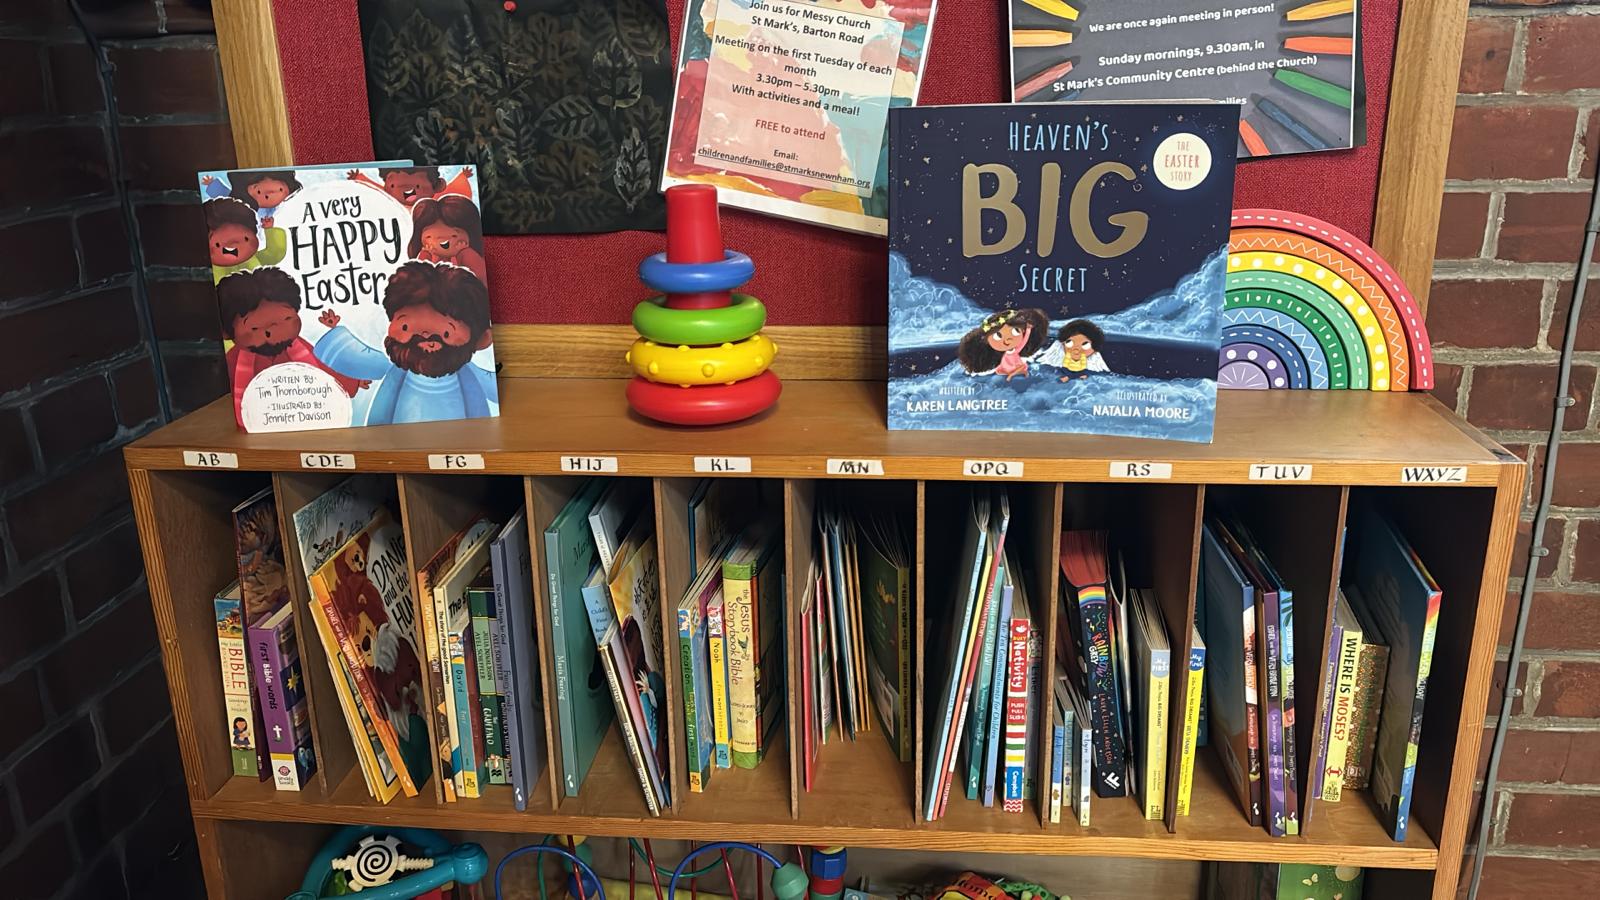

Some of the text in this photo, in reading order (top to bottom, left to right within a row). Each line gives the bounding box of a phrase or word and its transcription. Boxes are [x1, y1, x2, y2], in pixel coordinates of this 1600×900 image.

[749, 0, 871, 29] Join us for Messy Church
[1089, 3, 1274, 32] We are once again meeting in person!
[751, 15, 864, 44] St Mark's, Barton Road
[714, 35, 892, 75] Meeting on the first Tuesday of each
[1098, 40, 1264, 66] Sunday mornings, 9.30am, in
[784, 64, 816, 77] month
[1053, 55, 1317, 92] St Mark's Community Centre (behind the Church)
[756, 73, 792, 87] 3.30pm
[802, 82, 840, 97] 5.30pm
[732, 84, 755, 96] With
[757, 89, 800, 105] activities
[802, 97, 821, 108] and
[831, 104, 860, 116] meal!
[755, 119, 826, 140] FREE to attend
[1008, 121, 1109, 151] HEAVEN'S
[773, 149, 799, 161] Email:
[1177, 140, 1190, 151] THE
[697, 147, 871, 189] childrenandfamilies@stmarksnewnham.org
[1164, 153, 1200, 169] EASTER
[1170, 169, 1192, 182] STORY
[302, 195, 362, 223] A very
[961, 161, 1149, 258] BIG
[289, 217, 401, 270] HAPPY
[302, 262, 386, 310] Easter
[1018, 263, 1088, 293] SECRET
[255, 383, 333, 399] Tim Thornborough
[271, 375, 314, 384] WRITTEN BY
[263, 411, 332, 425] Jennifer Davison
[271, 401, 322, 411] ILLUSTRATED BY
[906, 399, 1008, 412] KAREN LANGTREE
[1092, 405, 1190, 419] NATALIA MOORE
[197, 453, 220, 466] AB
[305, 455, 344, 468] CDE
[445, 455, 467, 468] FG
[570, 457, 603, 471] HIJ
[710, 458, 735, 471] KL
[839, 461, 870, 473] MN
[970, 461, 1009, 475] OPQ
[1126, 463, 1151, 477] RS
[1256, 465, 1304, 479] TUV
[1404, 467, 1462, 482] WXYZ
[736, 595, 752, 633] Jesus
[726, 601, 742, 686] Storybook Bible
[1089, 645, 1098, 665] GREY
[1092, 633, 1109, 678] RAINBOW
[228, 648, 246, 689] BIBLE
[259, 642, 278, 709] first Bible words
[485, 648, 493, 680] DONALDSON
[556, 655, 566, 700] Maria Fearing
[682, 644, 691, 685] Creation
[994, 647, 1005, 700] Commandments
[1011, 641, 1026, 688] Nativity
[455, 669, 464, 693] David
[607, 670, 620, 702] CHRISTMAS
[1334, 638, 1357, 741] WHERE IS MOSES?
[992, 700, 1000, 709] for
[483, 708, 494, 745] GRUFFALO
[990, 710, 999, 739] Children
[1098, 693, 1106, 713] LAURA
[1102, 736, 1112, 764] ANDERSON
[1010, 770, 1019, 797] Campbell
[644, 787, 654, 810] SCHUSTER
